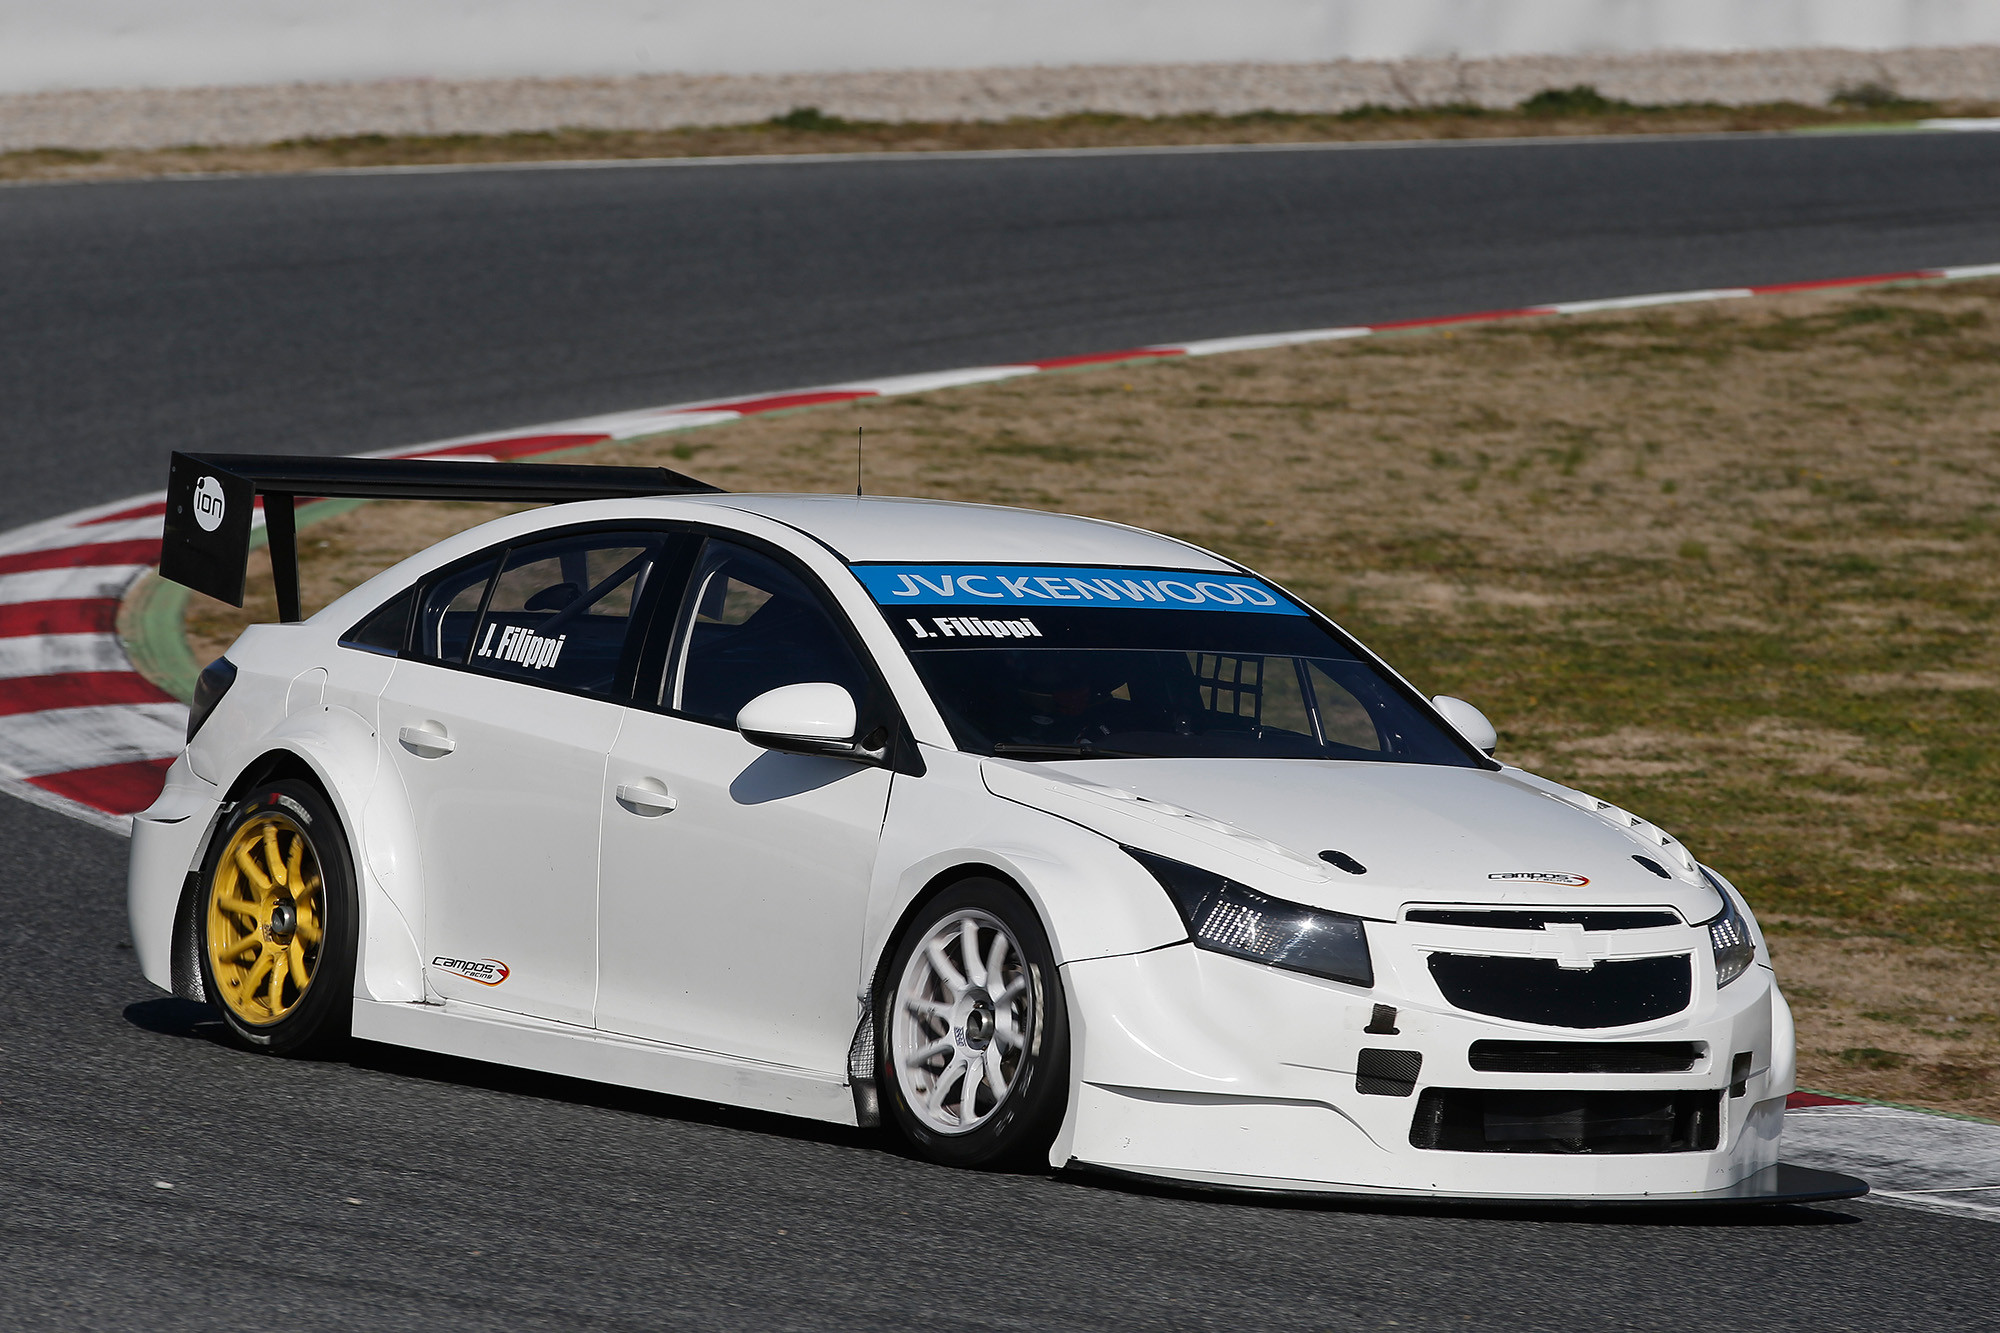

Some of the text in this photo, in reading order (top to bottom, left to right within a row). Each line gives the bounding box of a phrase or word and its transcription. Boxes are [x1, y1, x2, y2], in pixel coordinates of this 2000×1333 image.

[197, 477, 223, 519] ion
[906, 616, 1043, 639] J. Filippi
[478, 623, 566, 669] J. Filippi
[432, 956, 496, 974] campos
[464, 970, 493, 979] racing
